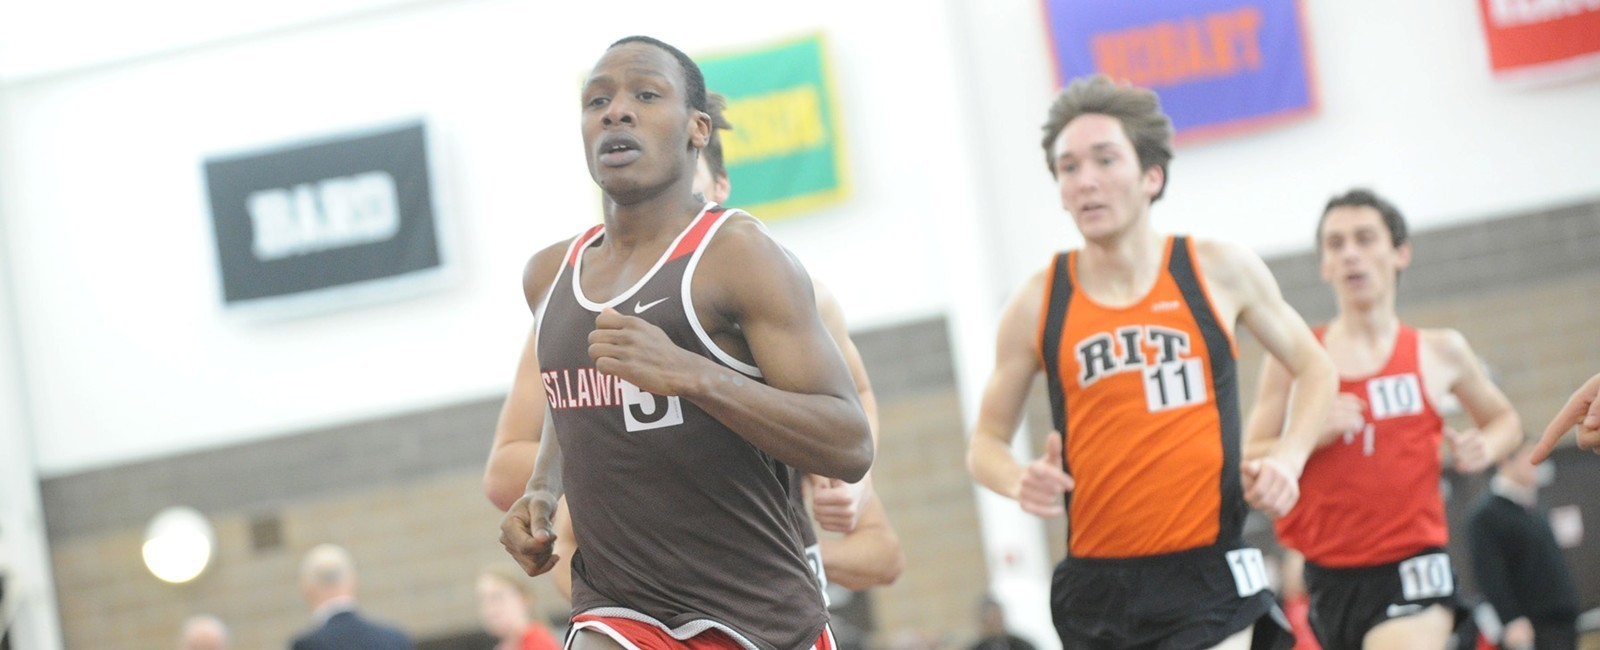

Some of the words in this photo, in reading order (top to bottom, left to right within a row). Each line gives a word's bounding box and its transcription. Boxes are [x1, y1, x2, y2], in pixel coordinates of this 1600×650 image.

[1075, 324, 1190, 388] RIT
[1150, 365, 1193, 406] 11
[1376, 377, 1414, 416] 10
[1407, 557, 1446, 598] 10
